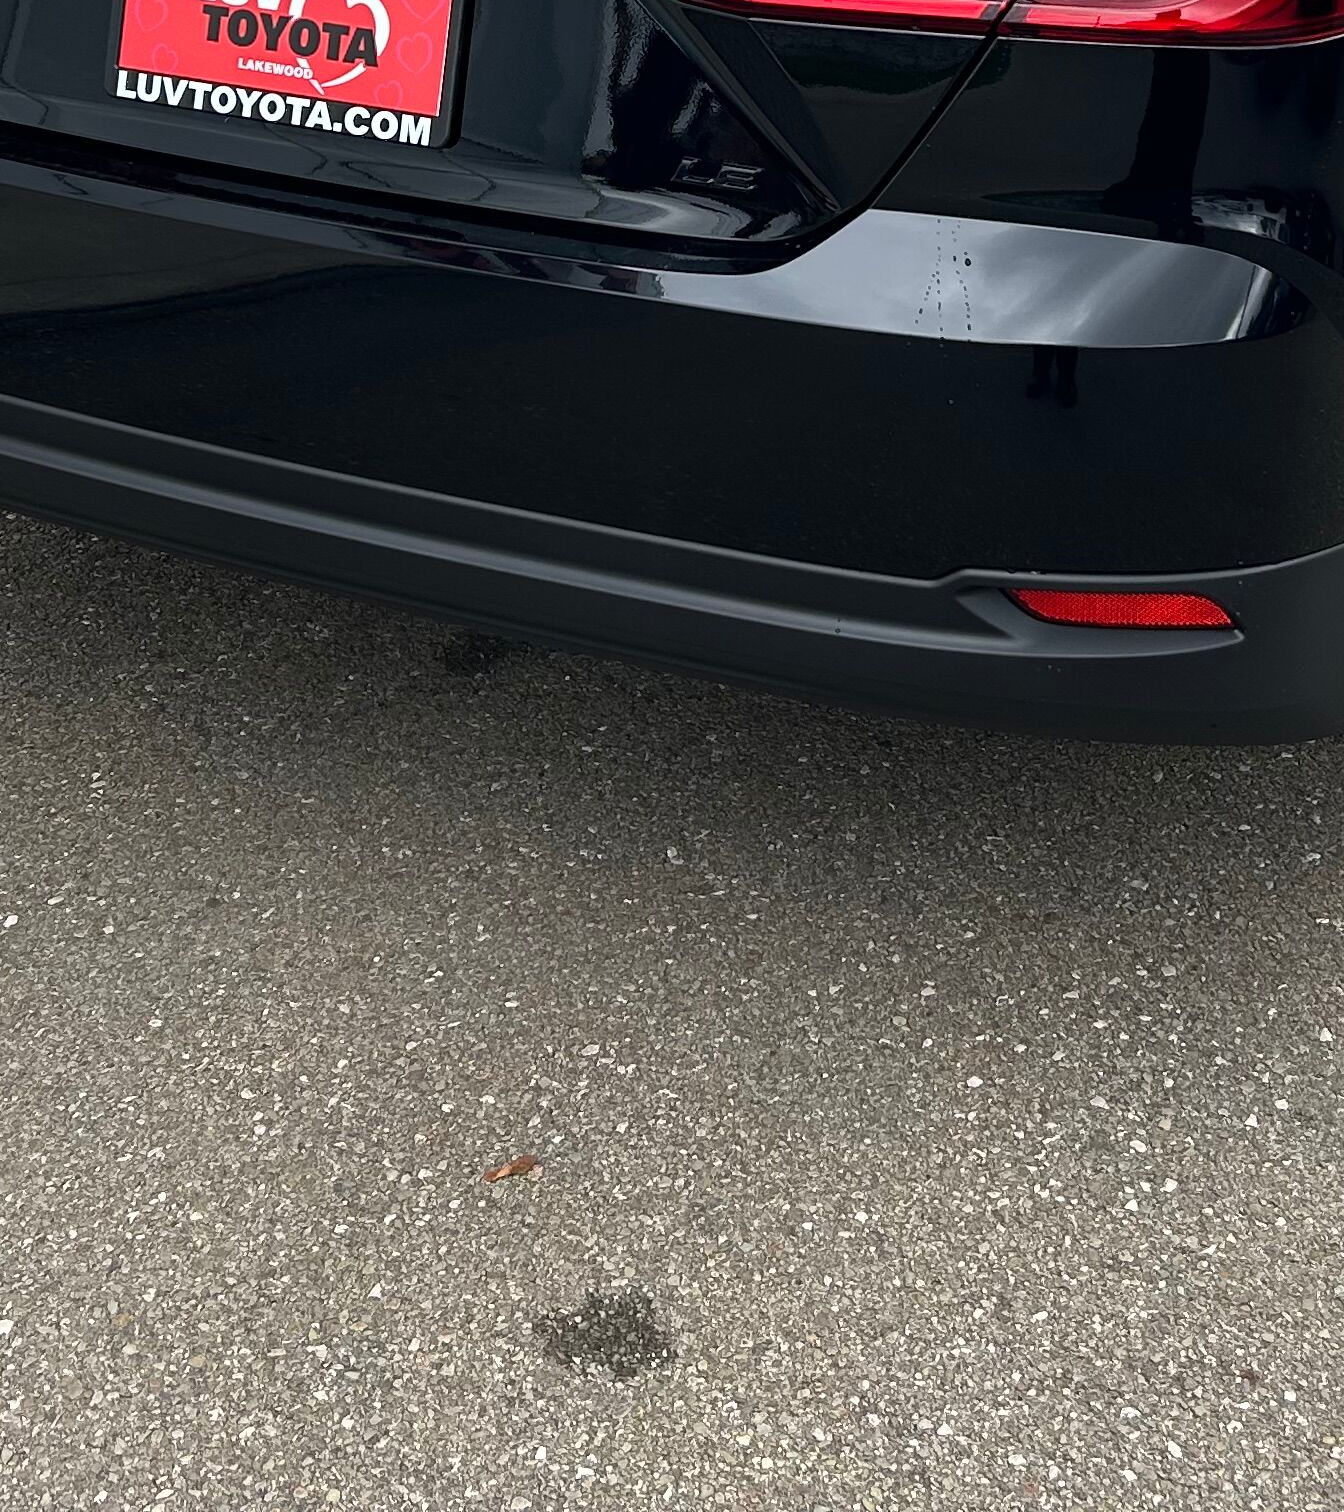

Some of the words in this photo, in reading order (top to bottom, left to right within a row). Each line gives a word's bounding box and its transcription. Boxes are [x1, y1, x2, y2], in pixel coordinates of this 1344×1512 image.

[202, 4, 379, 68] TOYOTA
[237, 56, 314, 80] LAKEWOOD
[115, 70, 433, 148] LUVTOYOTA.COM
